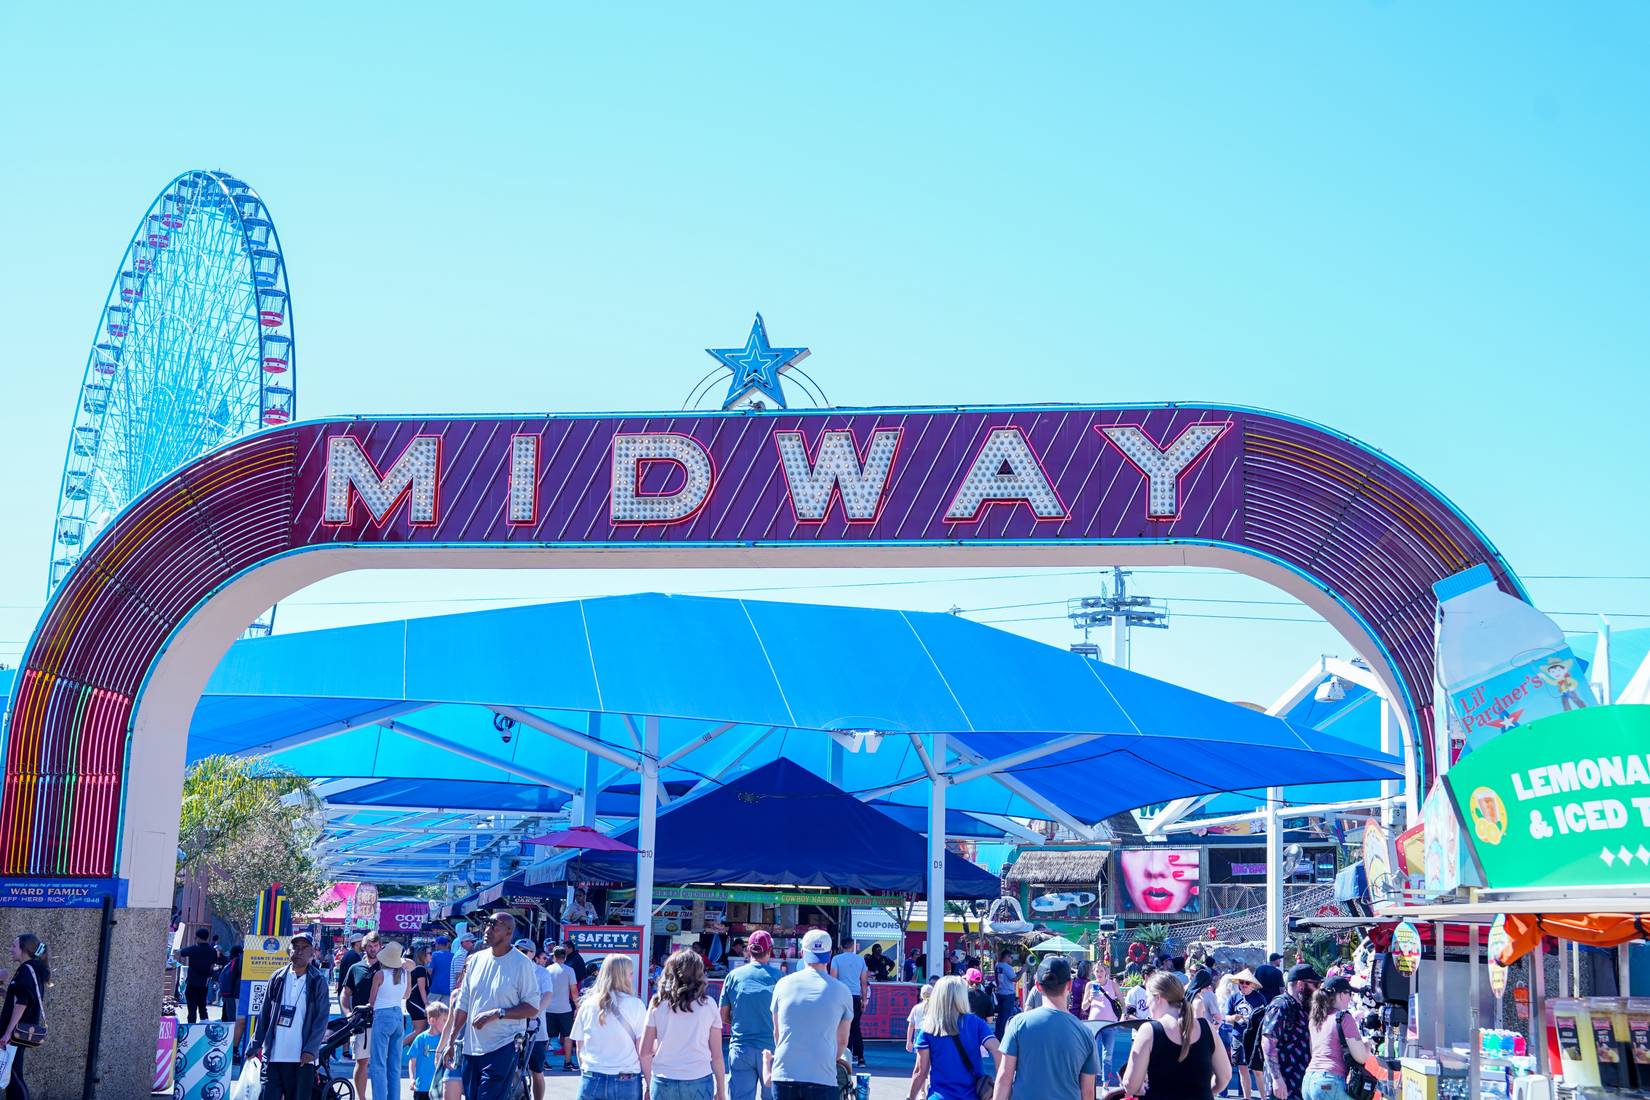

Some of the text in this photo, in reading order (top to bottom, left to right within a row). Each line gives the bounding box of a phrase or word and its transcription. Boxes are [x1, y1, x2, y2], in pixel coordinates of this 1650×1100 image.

[322, 421, 1233, 526] MIDWAY
[1460, 686, 1485, 713] Lil'
[1462, 675, 1544, 733] Pardner's
[1511, 754, 1650, 801] LEMONA
[1529, 810, 1553, 839] &
[1553, 799, 1628, 834] ICED
[934, 860, 943, 869] D9
[48, 888, 89, 896] FAMILY
[577, 933, 629, 943] SAFETY
[856, 921, 900, 930] COUPONS
